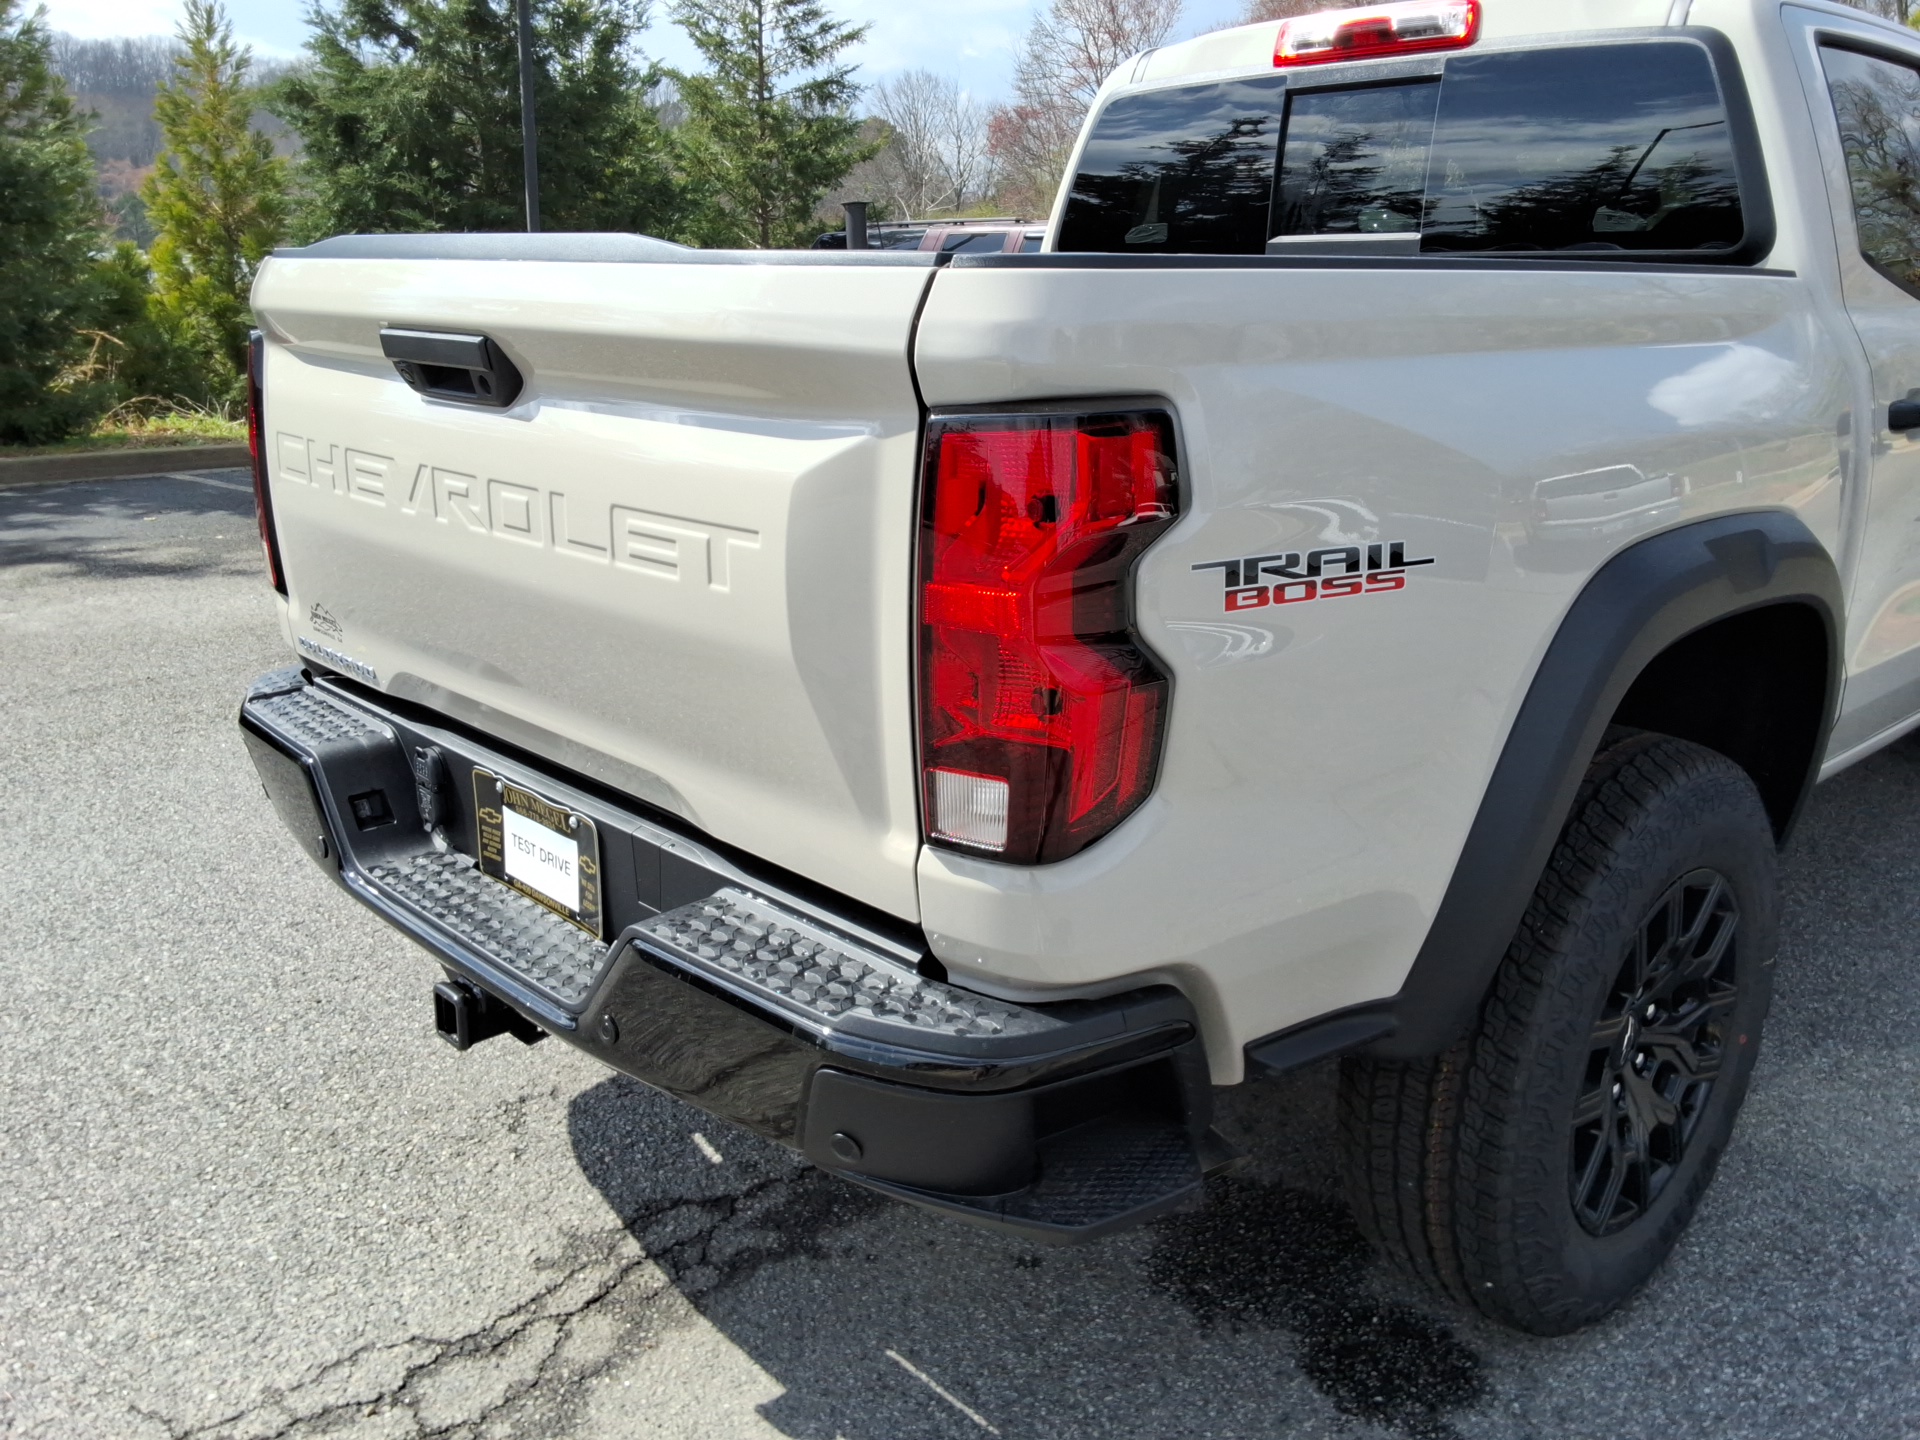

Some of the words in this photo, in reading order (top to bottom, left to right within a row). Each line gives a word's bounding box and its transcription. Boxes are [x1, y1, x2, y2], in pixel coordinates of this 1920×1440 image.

[277, 431, 760, 592] CHEVROLET
[1191, 541, 1435, 588] TRAIL
[1224, 569, 1406, 612] BOSS
[504, 787, 530, 808] JOHN
[530, 798, 571, 833] MEGEL
[511, 832, 537, 855] TEST
[539, 847, 571, 877] DRIVE
